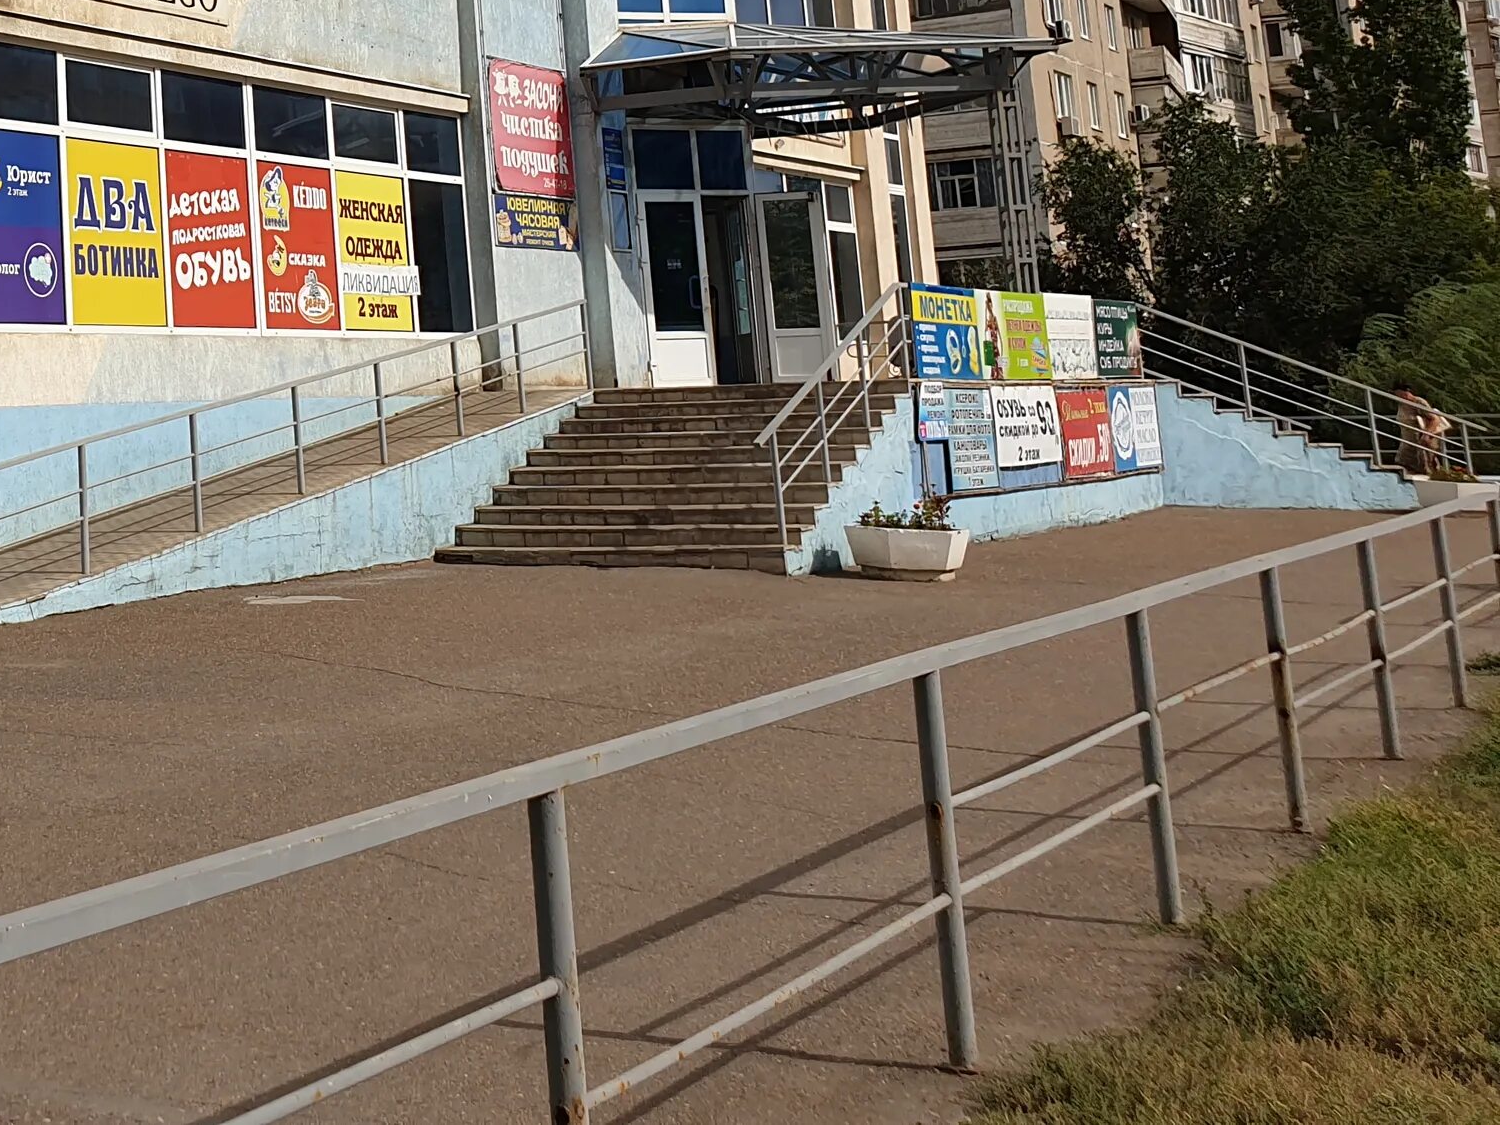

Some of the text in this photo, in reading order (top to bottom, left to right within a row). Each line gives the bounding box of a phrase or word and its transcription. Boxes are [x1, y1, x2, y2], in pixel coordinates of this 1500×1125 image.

[7, 165, 51, 186] Юрист
[7, 187, 28, 197] 2 этаж
[75, 174, 156, 233] ДВА
[339, 198, 403, 224] ЖЕНСКАЯ
[515, 213, 560, 229] ЧАСОВАЯ
[346, 235, 402, 261] ОДЕЖДА
[74, 244, 159, 278] БОТИНКА
[343, 272, 419, 294] ЛИКВИДАЦИЯ
[358, 297, 398, 319] 2 этаж
[919, 295, 973, 322] МОНЕТКА
[997, 398, 1026, 418] ОБУВЬ
[1018, 446, 1040, 461] 2 этаж
